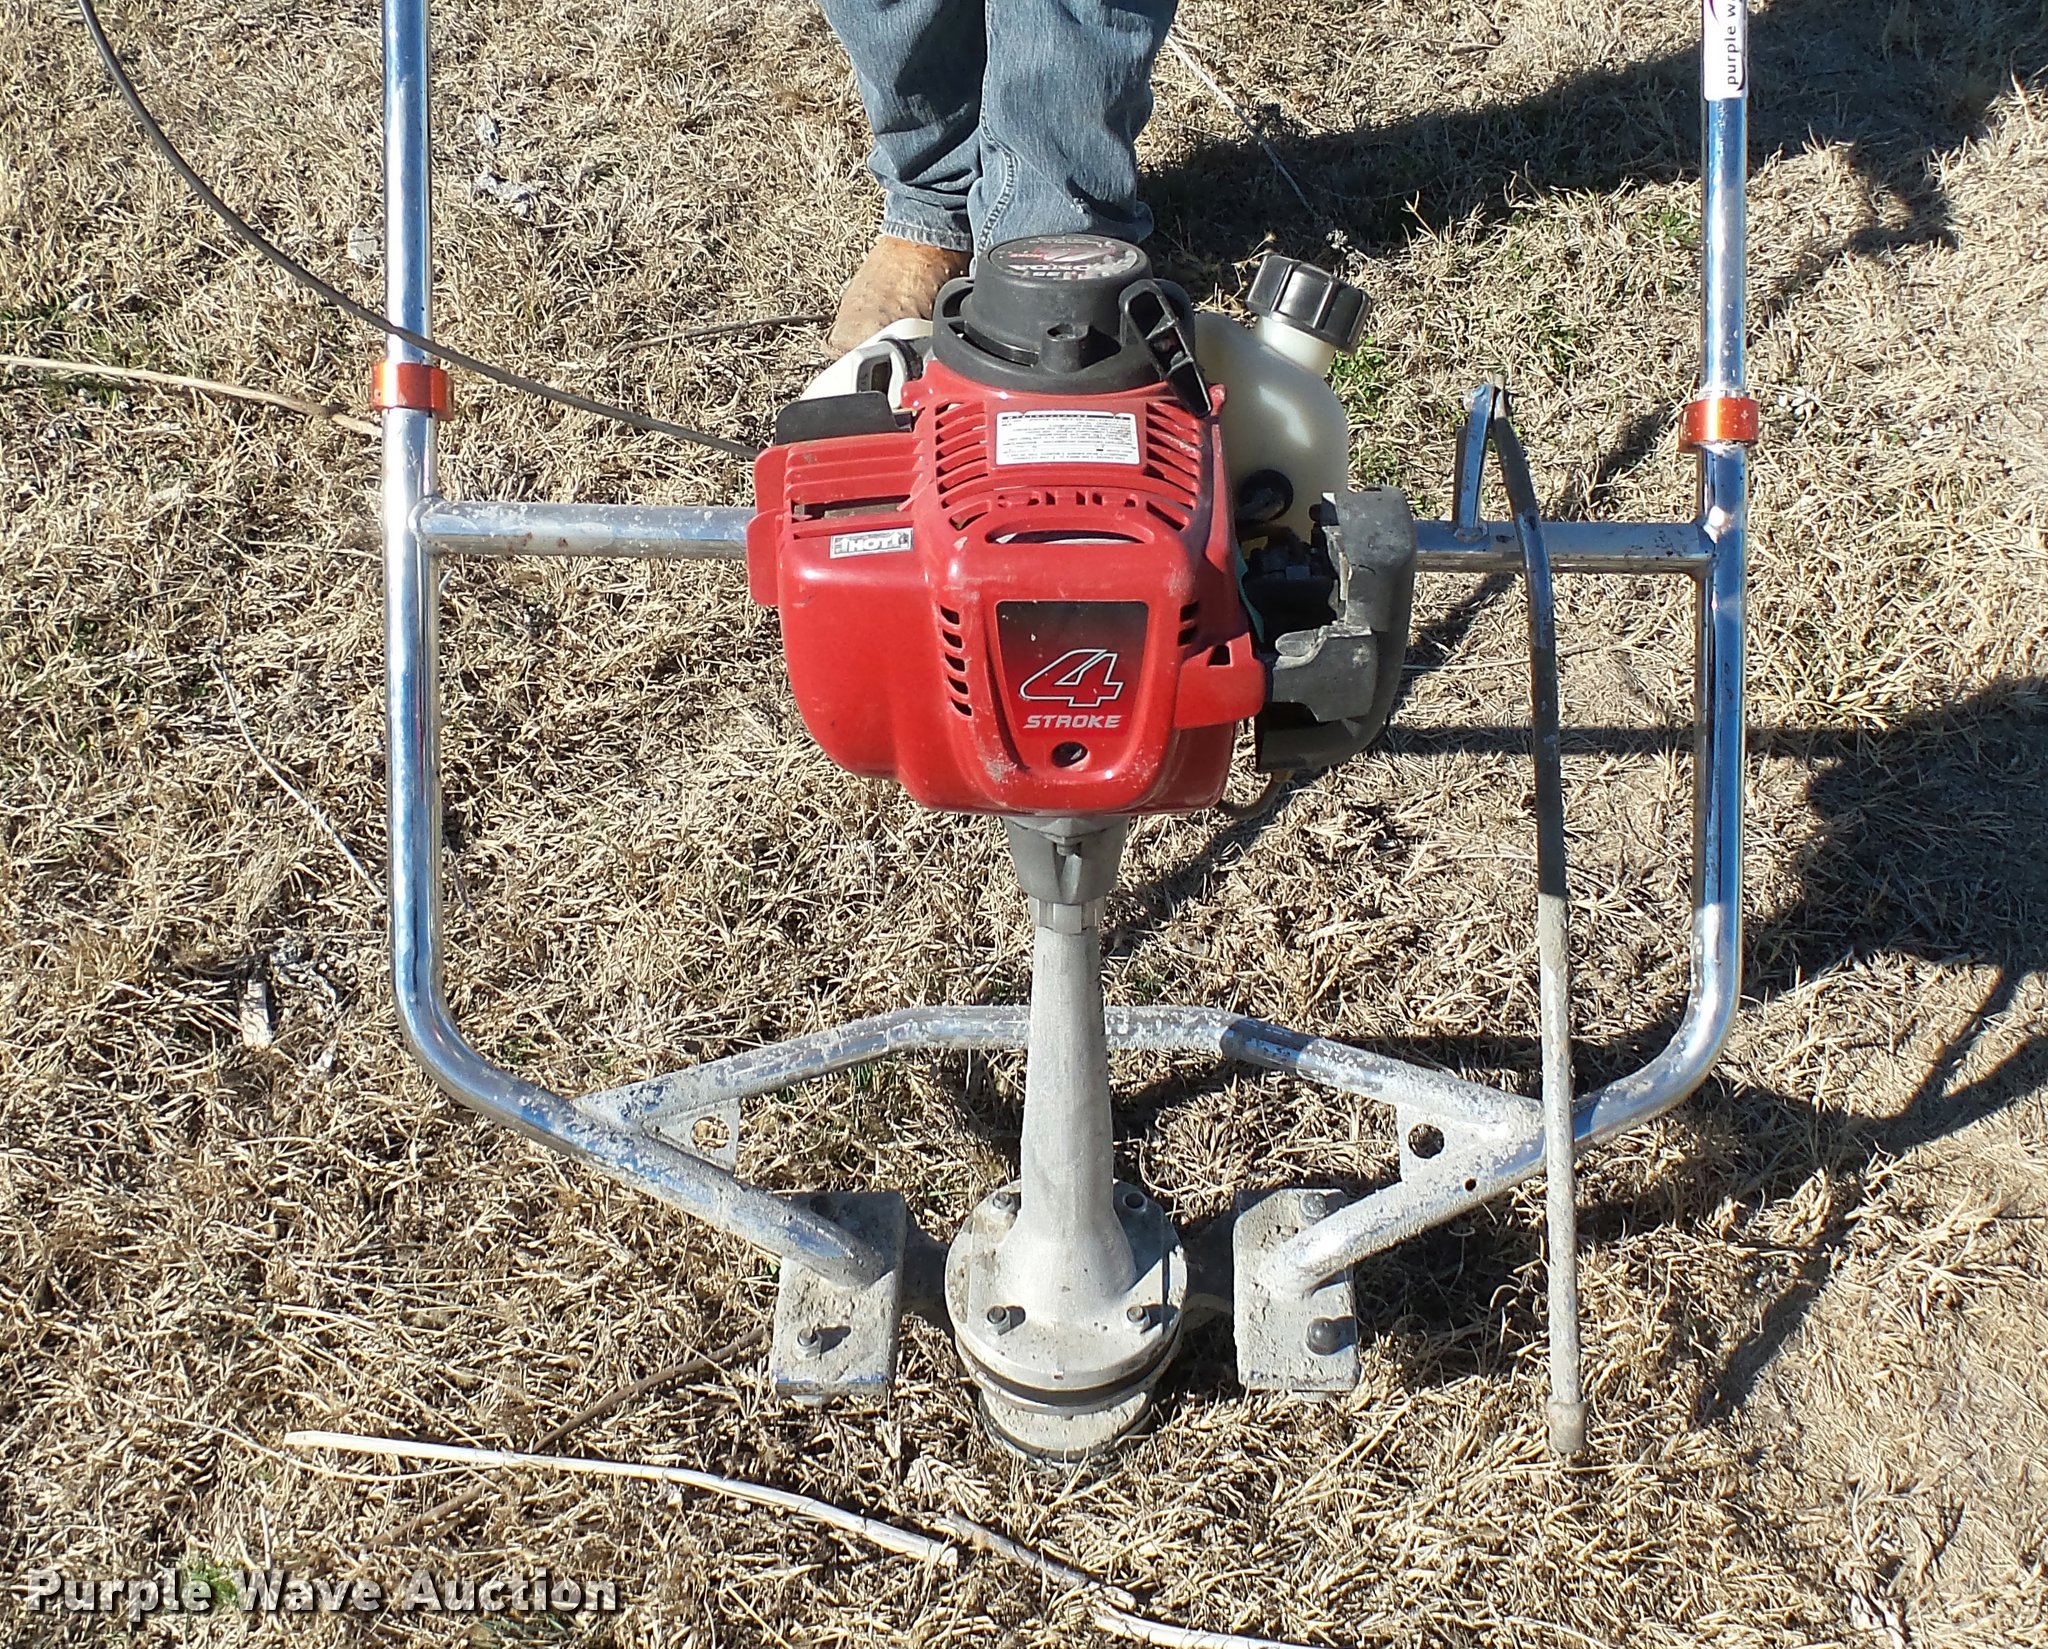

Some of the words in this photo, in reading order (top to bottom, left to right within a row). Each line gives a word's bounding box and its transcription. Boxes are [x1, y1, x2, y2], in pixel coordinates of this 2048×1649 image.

[1727, 0, 1736, 17] w
[1724, 26, 1740, 85] purple
[1020, 649, 1124, 707] 4
[1023, 715, 1122, 729] STROKE
